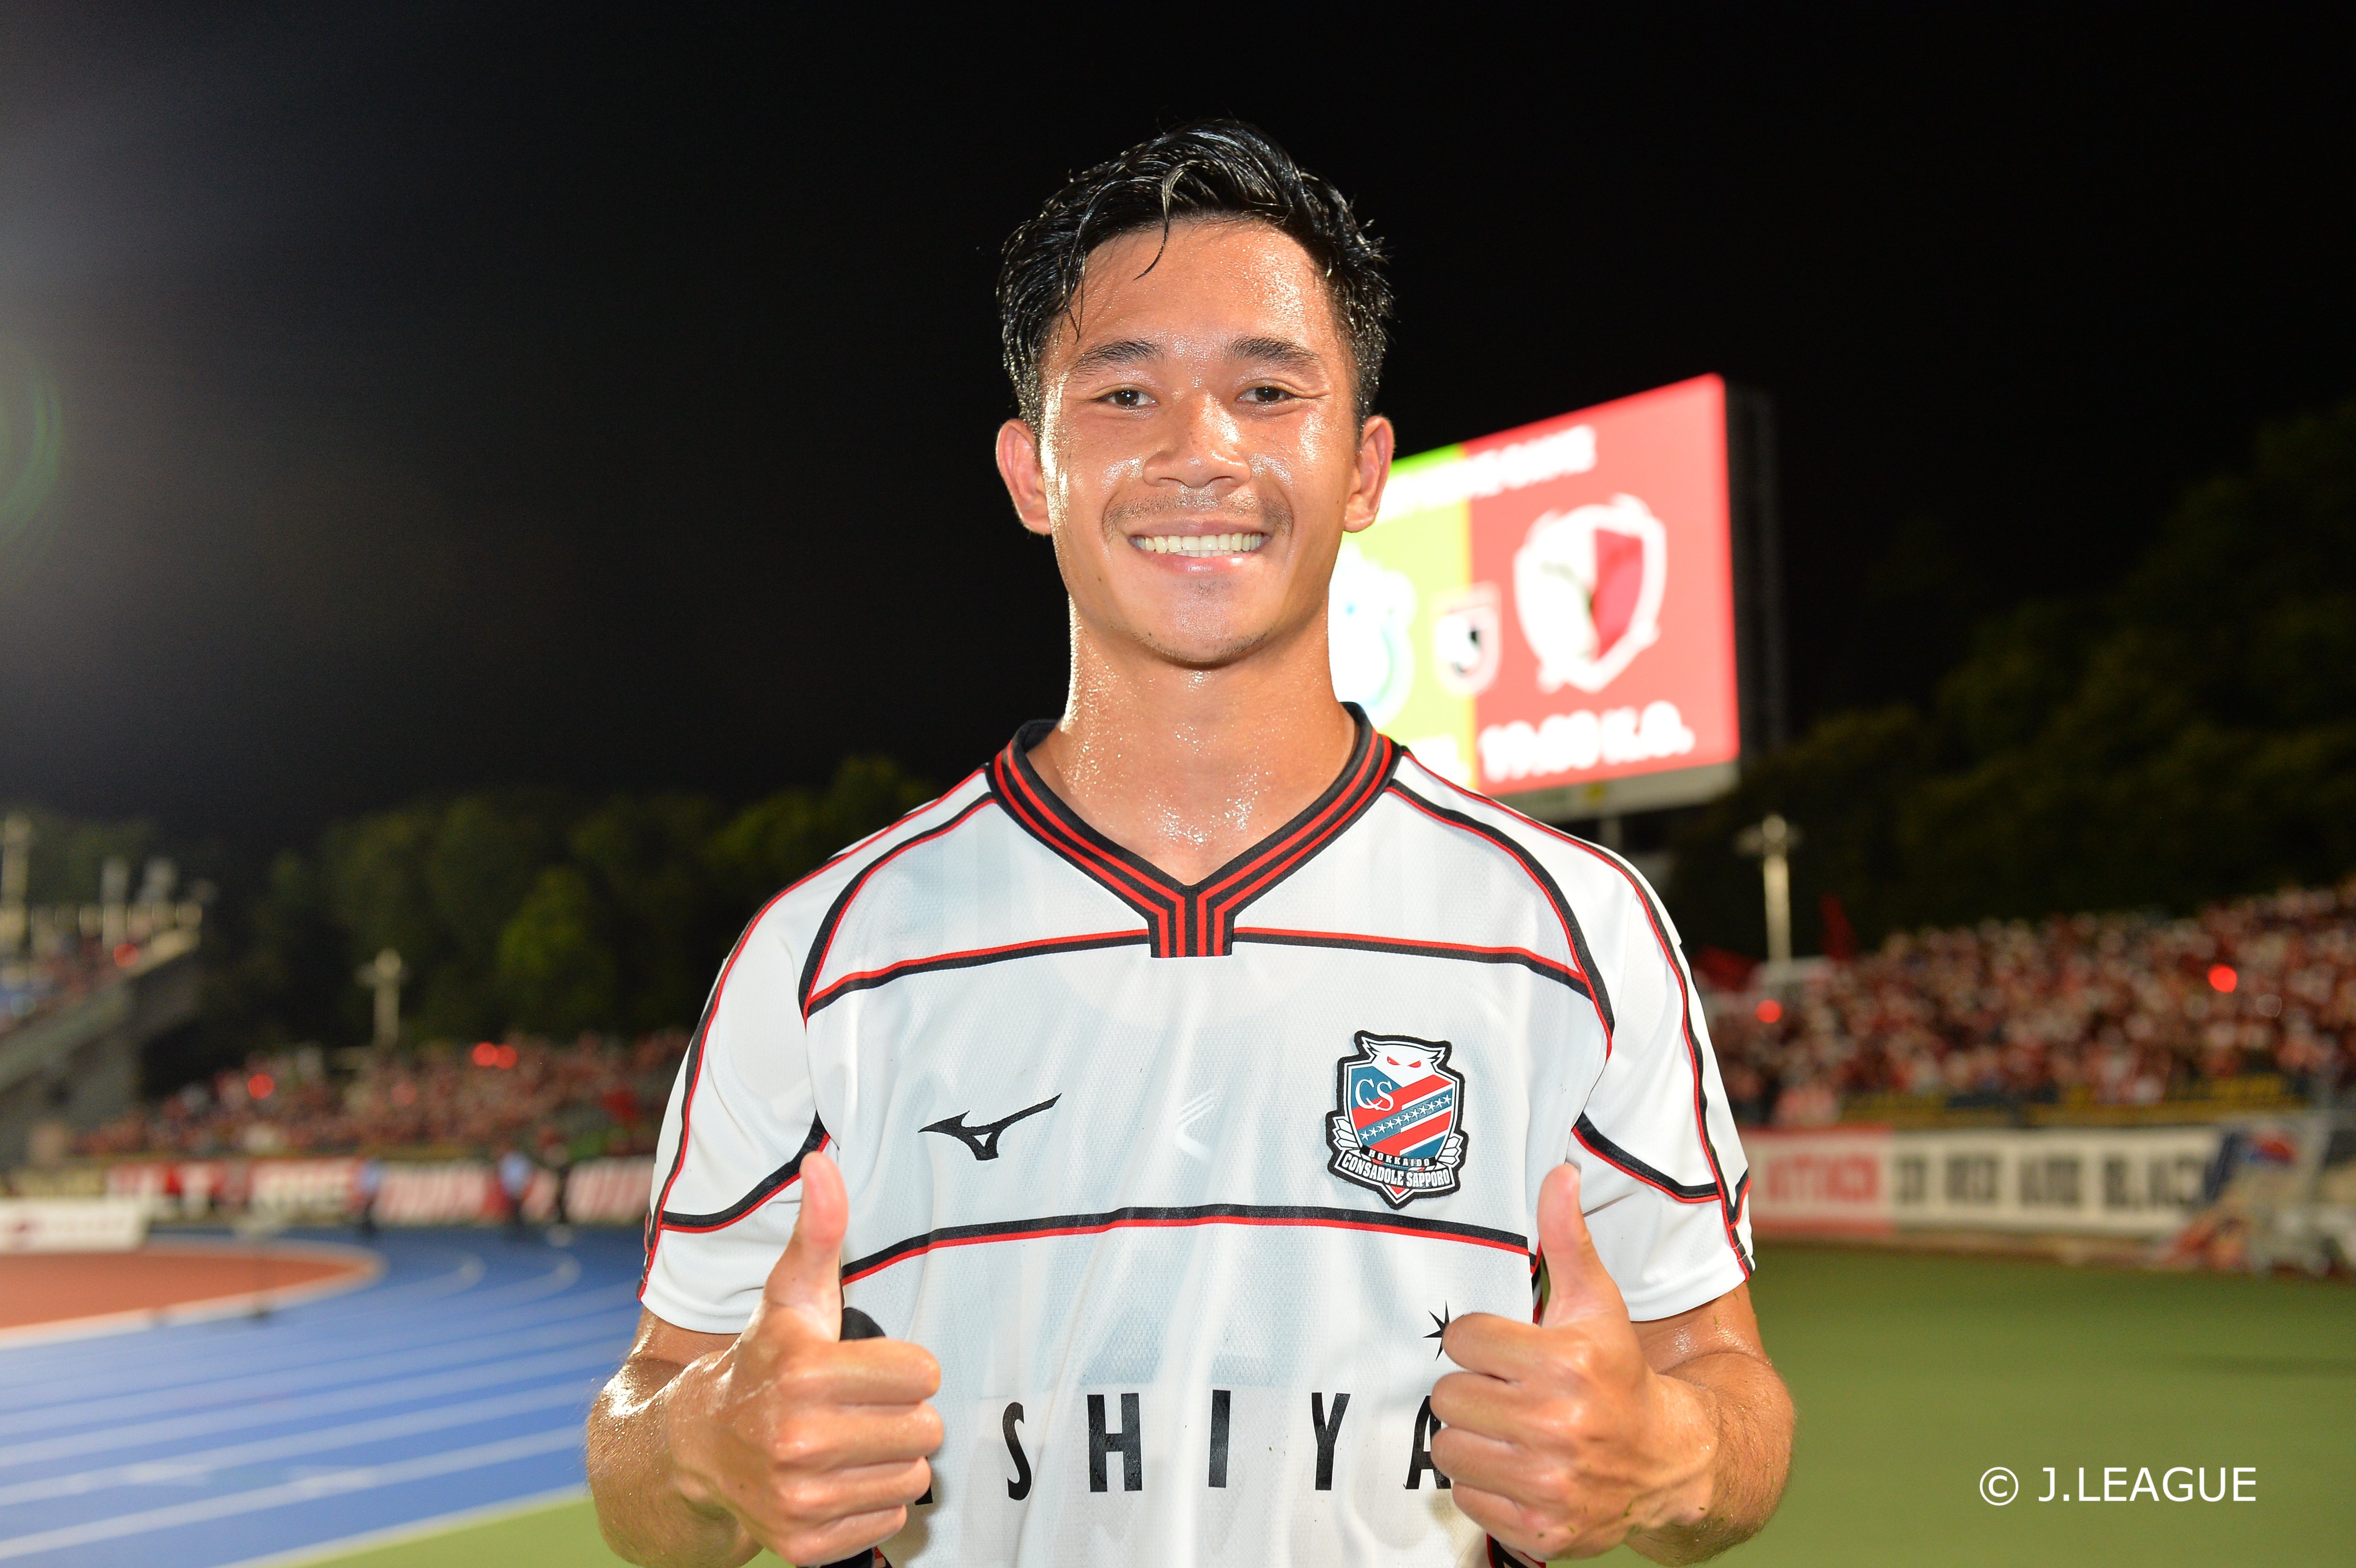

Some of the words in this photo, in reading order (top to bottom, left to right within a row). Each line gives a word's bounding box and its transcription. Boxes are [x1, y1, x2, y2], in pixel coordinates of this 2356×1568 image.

[1355, 1078, 1394, 1111] CS
[1342, 1154, 1404, 1187] CONSADOLE
[1406, 1169, 1451, 1188] SAPPORO
[1369, 1150, 1429, 1166] HOKKAIDO
[915, 1389, 1451, 1505] SHIYA
